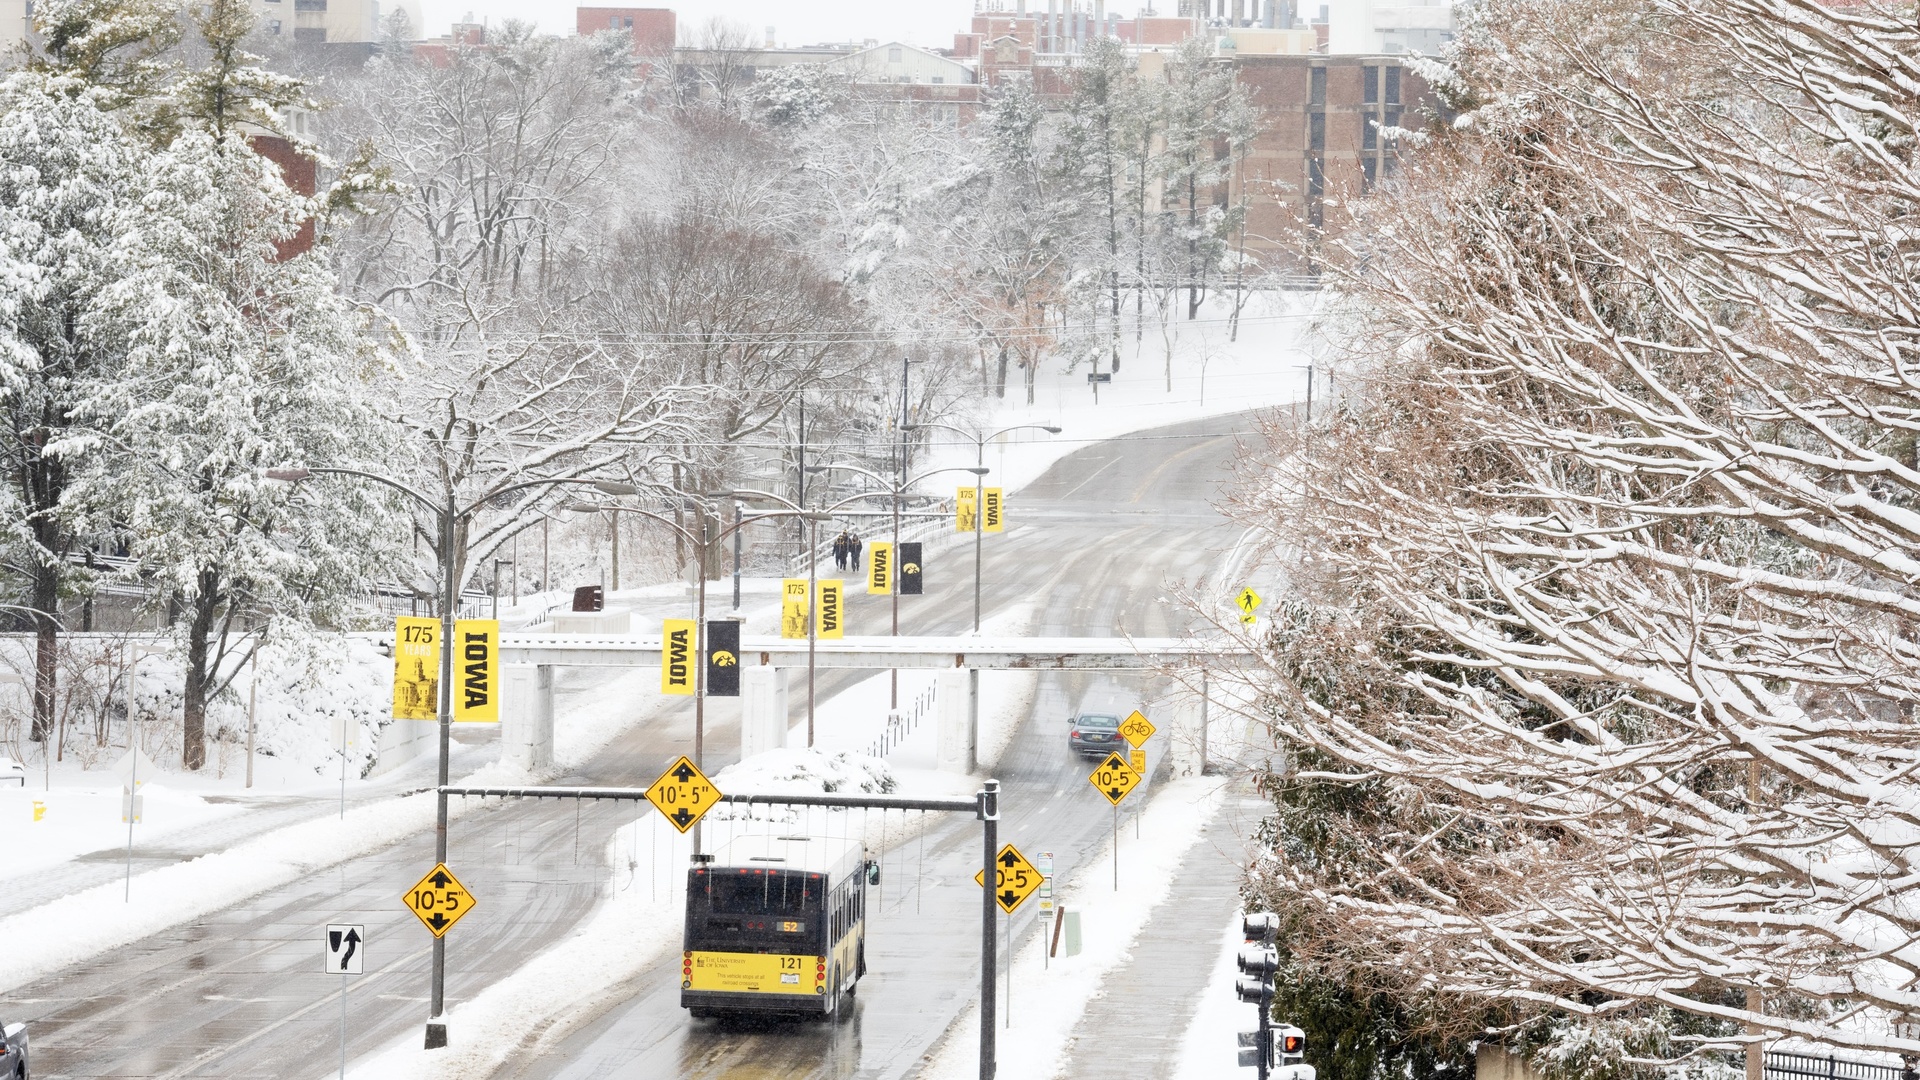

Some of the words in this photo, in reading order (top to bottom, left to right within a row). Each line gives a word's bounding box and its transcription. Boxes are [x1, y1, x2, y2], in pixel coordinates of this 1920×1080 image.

[960, 490, 974, 499] 175
[987, 492, 998, 527] IOWA
[874, 548, 887, 588] IOWA
[786, 584, 805, 595] 175
[823, 586, 837, 632] IOWA
[403, 625, 433, 643] 175
[404, 643, 432, 657] YEARS
[669, 628, 688, 686] IOWA
[464, 632, 488, 710] IOWA
[997, 868, 1032, 889] 0'-5"
[783, 921, 798, 933] 52
[780, 957, 802, 970] 121
